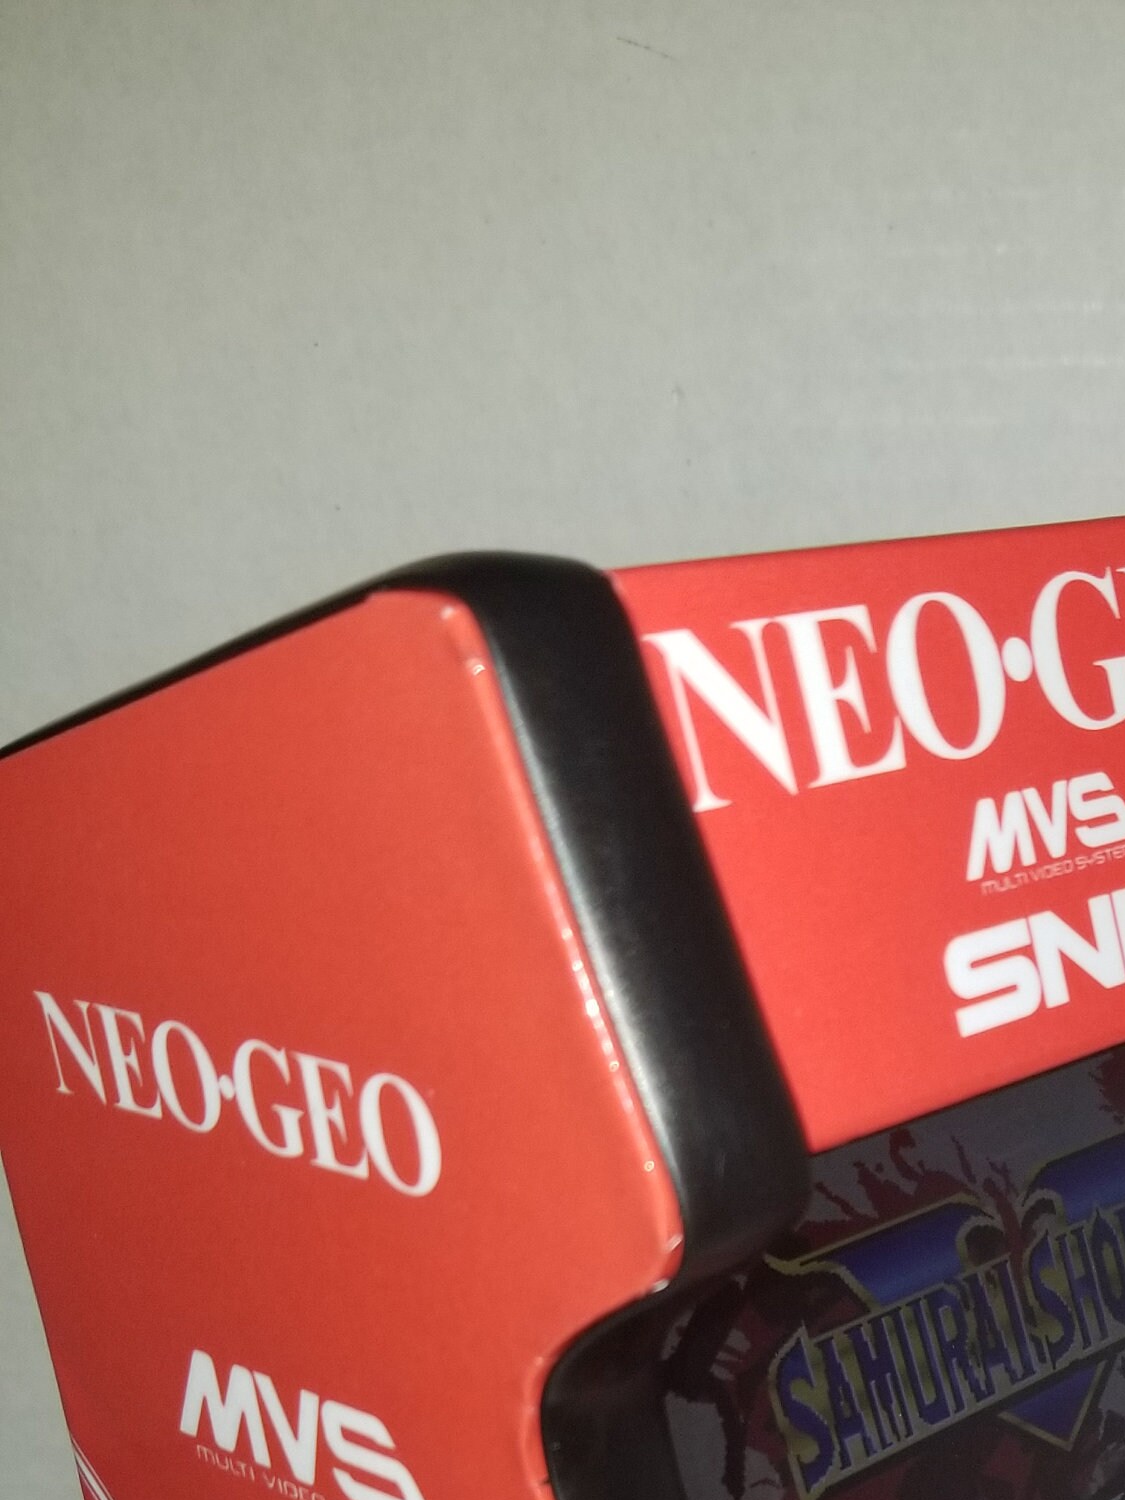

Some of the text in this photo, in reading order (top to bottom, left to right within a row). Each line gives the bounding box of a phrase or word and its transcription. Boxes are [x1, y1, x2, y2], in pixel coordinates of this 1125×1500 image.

[980, 871, 1028, 896] MULTI
[1029, 858, 1074, 882] VIDEO
[774, 1256, 1033, 1493] SAMURAI
[196, 1444, 255, 1482] MULTI
